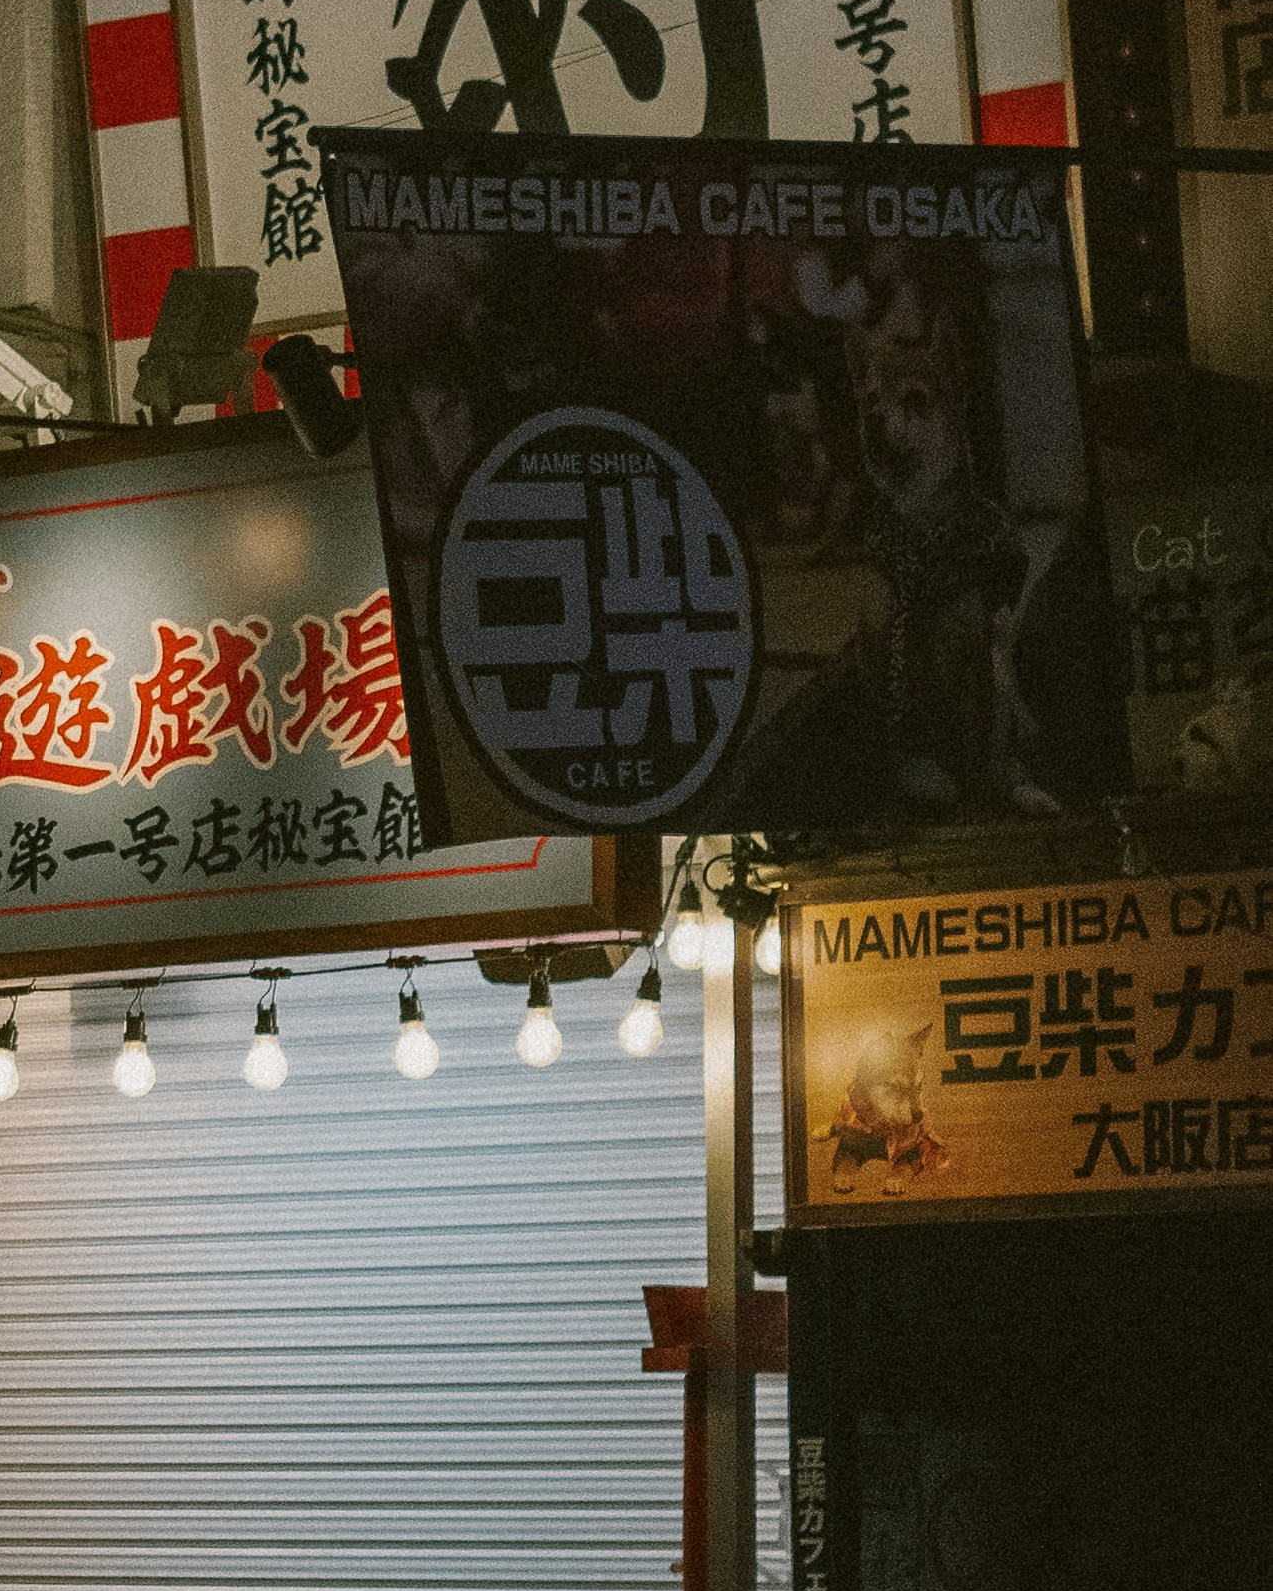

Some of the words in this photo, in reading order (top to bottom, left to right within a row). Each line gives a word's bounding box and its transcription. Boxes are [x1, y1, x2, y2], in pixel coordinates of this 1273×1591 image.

[344, 170, 682, 237] MAMESHIBA
[699, 181, 846, 239] CAFE
[865, 184, 1043, 242] OSAKA
[519, 451, 583, 475] MAME
[589, 451, 657, 476] SHIBA
[1131, 515, 1228, 572] Cat
[565, 760, 654, 789] CAFE
[813, 894, 1149, 965] MAMESHIBA
[939, 965, 1273, 1084] 豆柴カ
